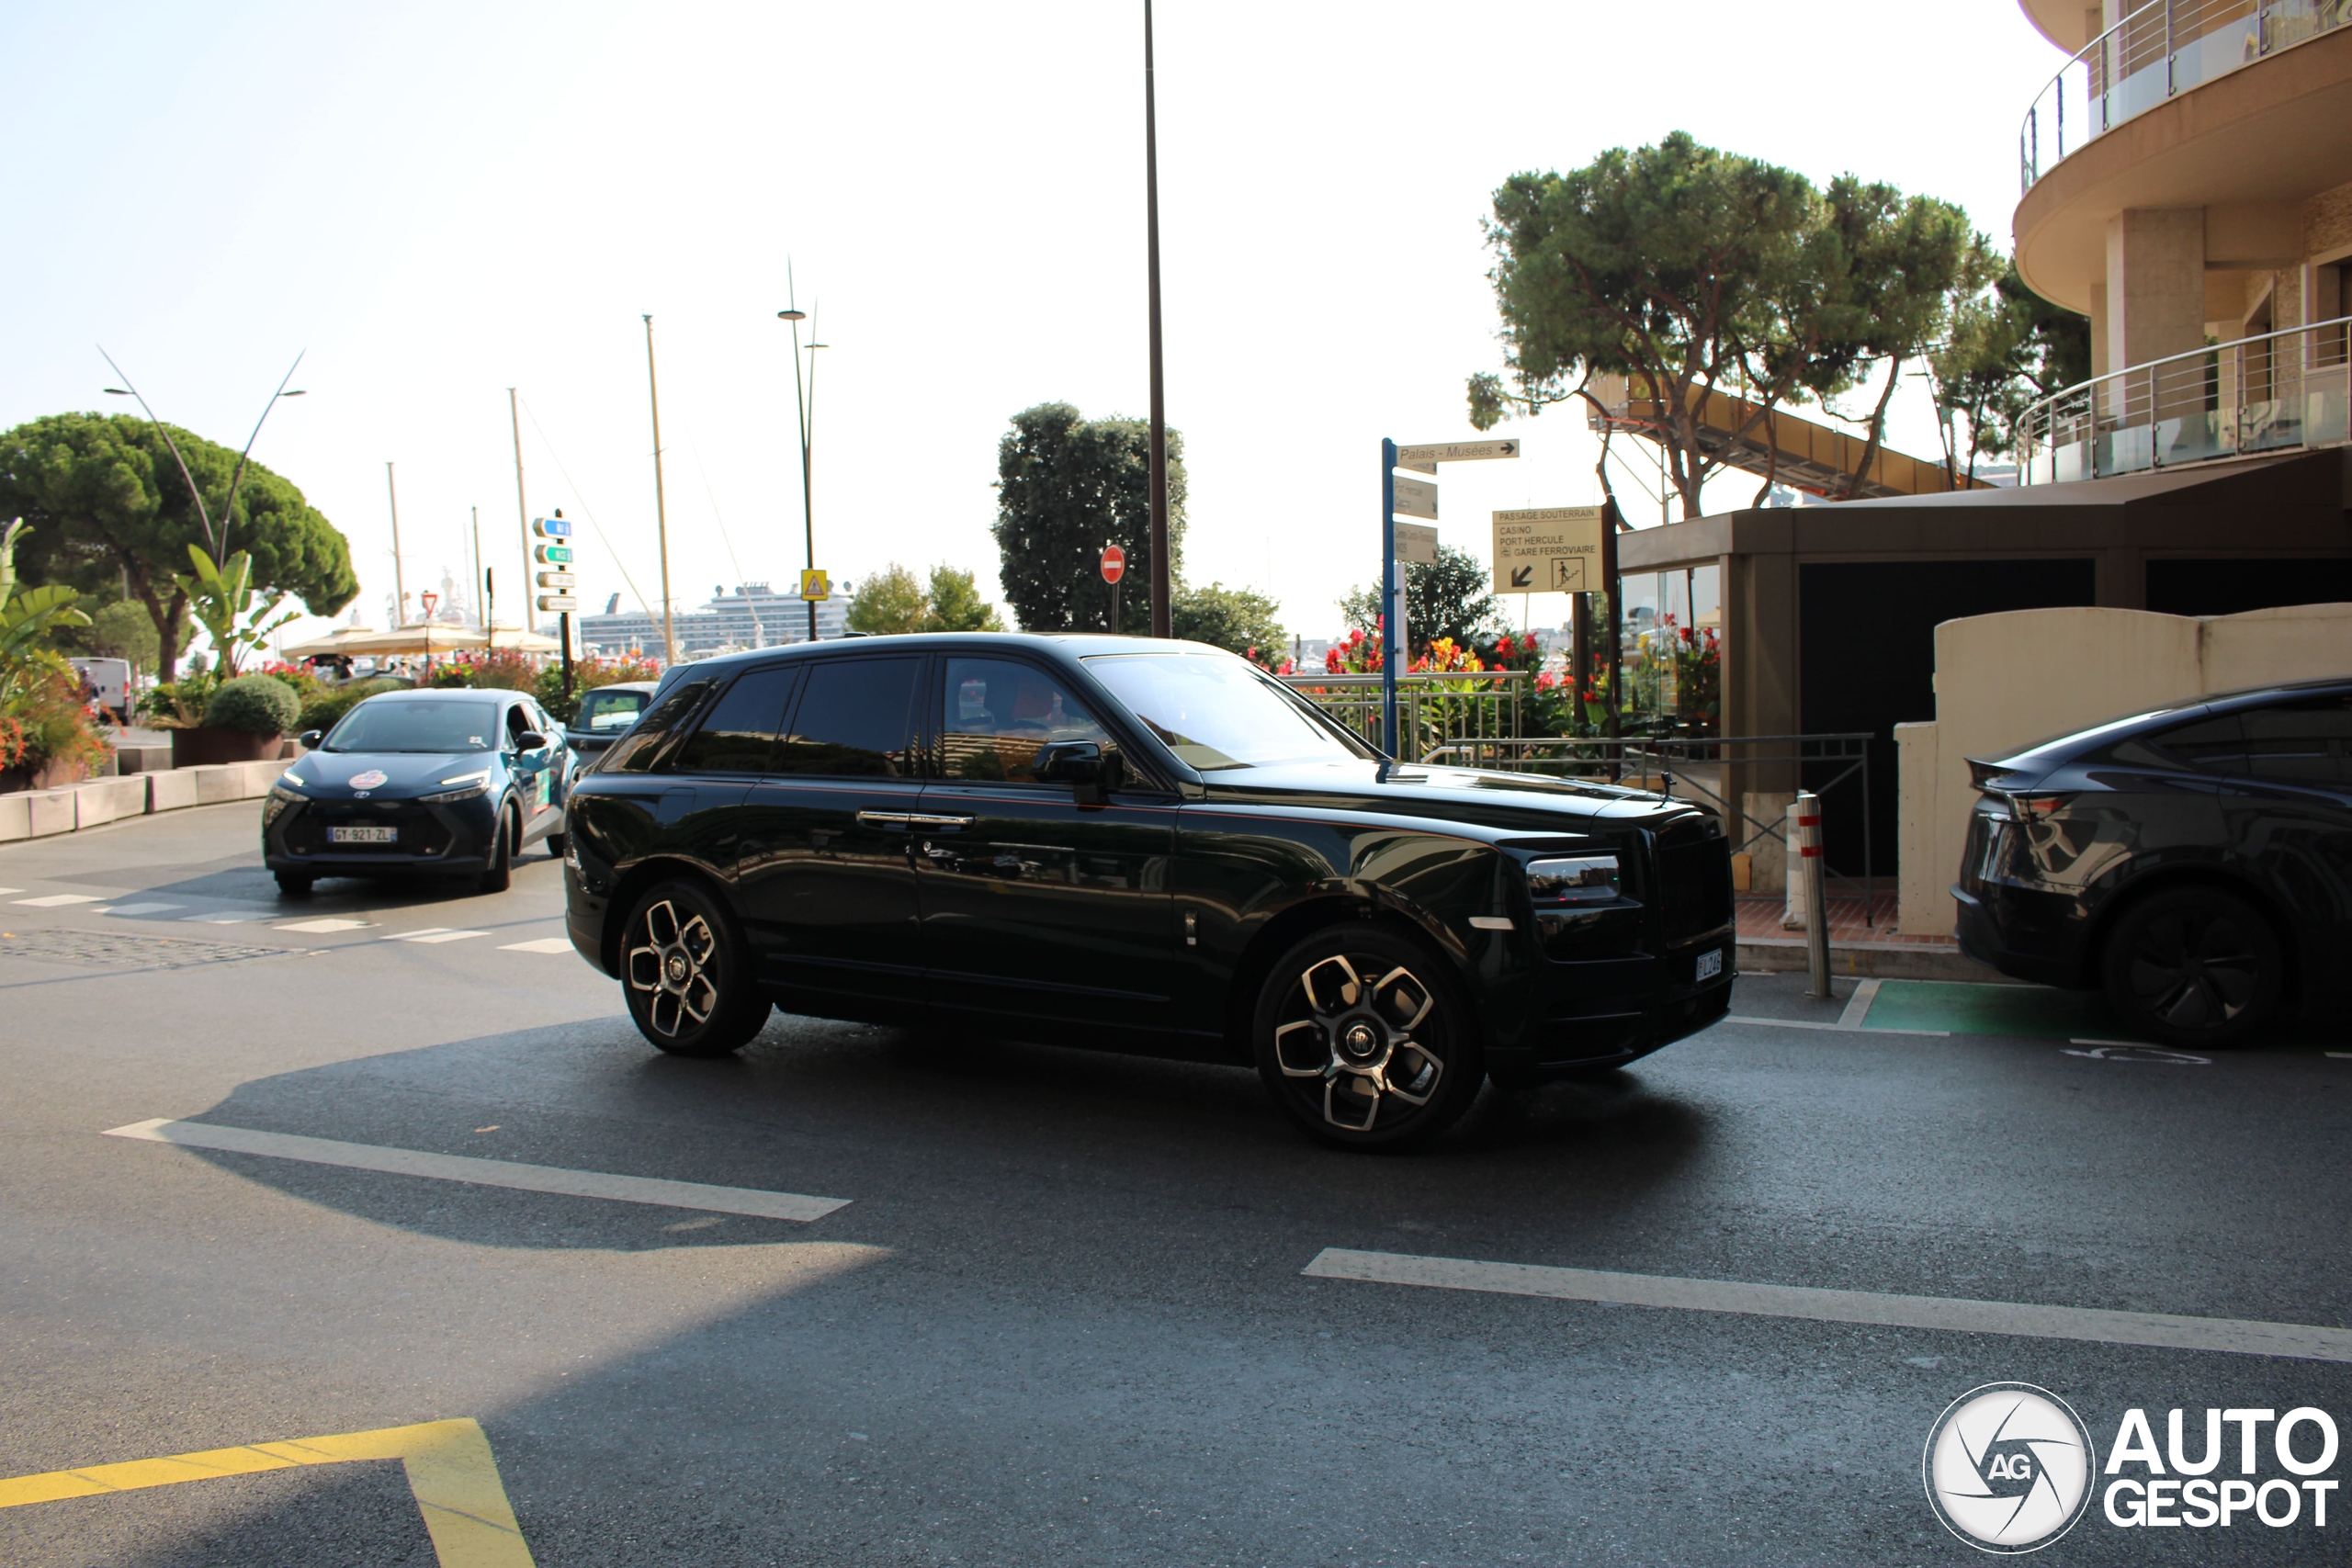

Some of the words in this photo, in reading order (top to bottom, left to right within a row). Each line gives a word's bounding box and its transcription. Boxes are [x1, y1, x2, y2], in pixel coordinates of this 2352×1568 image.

[1399, 448, 1435, 460] Palais
[1446, 446, 1493, 457] Musées
[1499, 512, 1538, 521] PASSAGE
[1540, 509, 1595, 520] SOUTERRAIN
[1499, 525, 1532, 536] CASINO
[1499, 537, 1522, 547] PORT
[1524, 536, 1564, 546] HERCULE
[1514, 547, 1538, 557] GARE
[1540, 545, 1596, 556] FERROVIAIRE
[334, 829, 390, 840] GY-921-ZL
